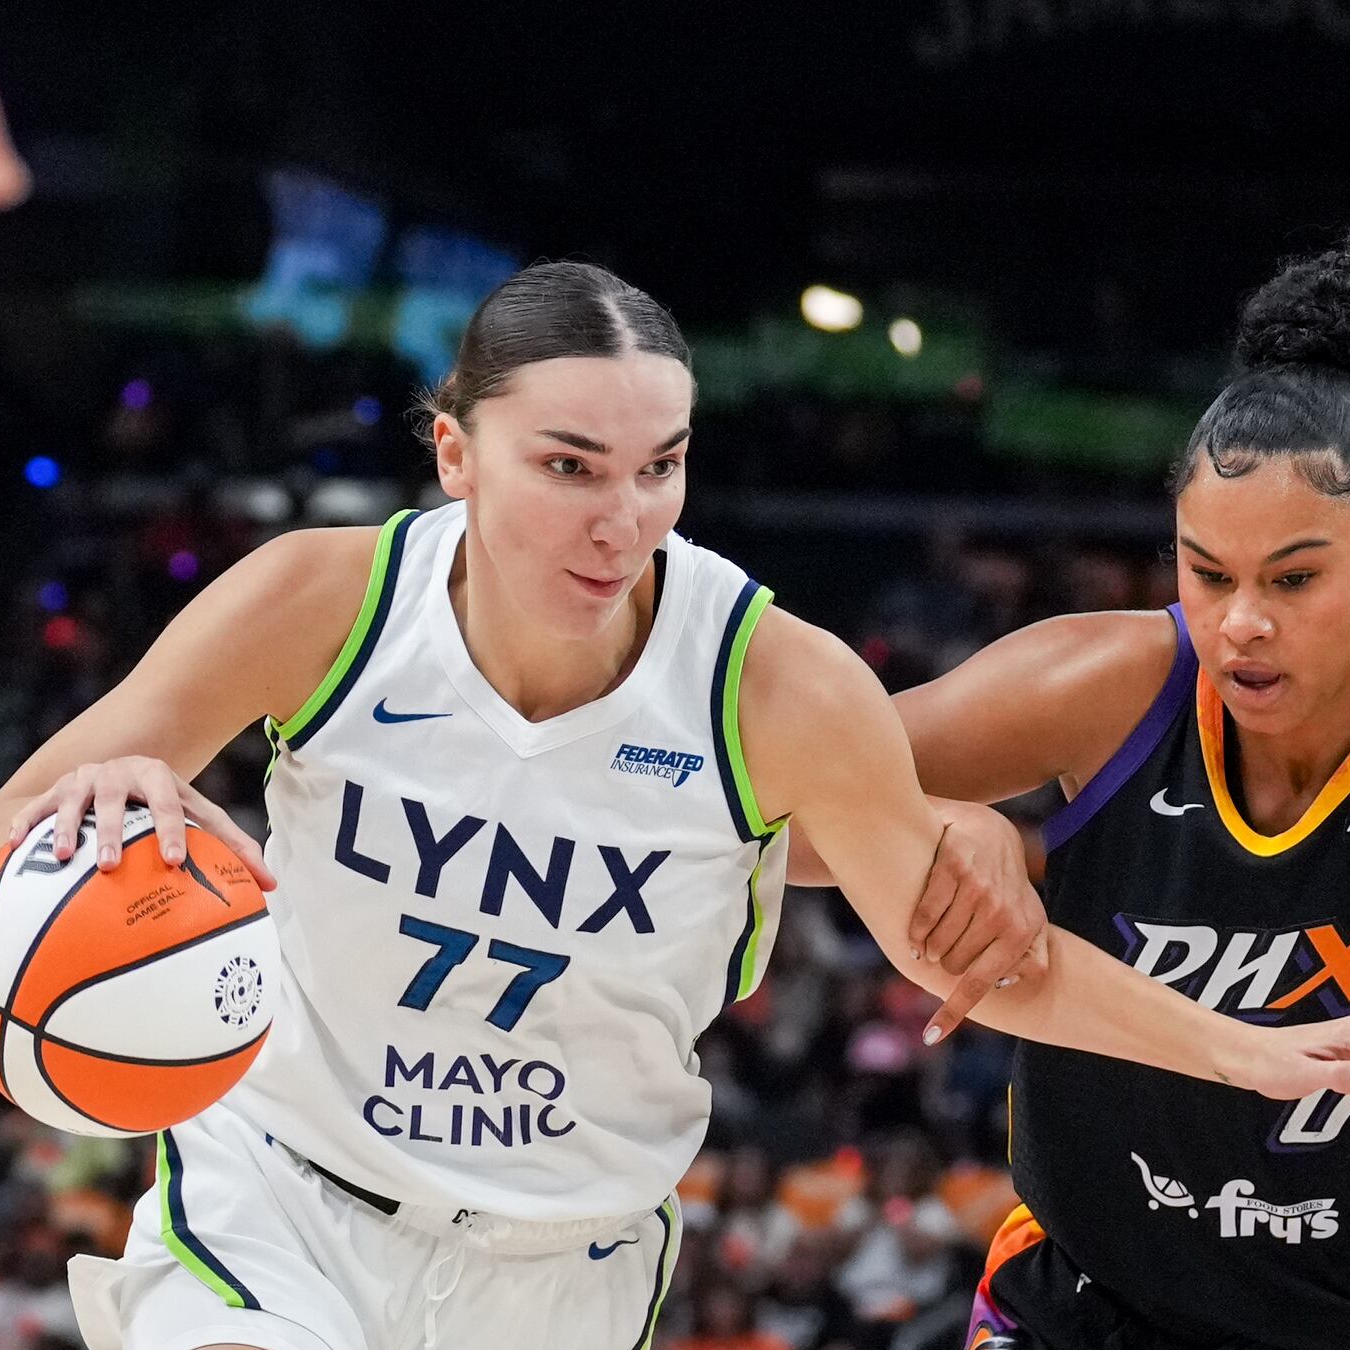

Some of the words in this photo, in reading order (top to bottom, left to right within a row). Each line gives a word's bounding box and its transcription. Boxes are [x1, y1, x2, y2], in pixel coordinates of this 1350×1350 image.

[610, 758, 673, 780] INSURANCE
[615, 743, 704, 772] FEDERATED
[334, 780, 671, 935] LYNX
[125, 901, 158, 926] GAME
[157, 887, 186, 909] BALL
[126, 883, 173, 913] OFFICIAL
[397, 913, 571, 1033] 77
[384, 1045, 566, 1101] MAYO
[363, 1095, 576, 1148] CLINIC
[1204, 1179, 1340, 1245] fry's
[1245, 1199, 1279, 1214] FOOD
[1282, 1199, 1324, 1215] STORES
